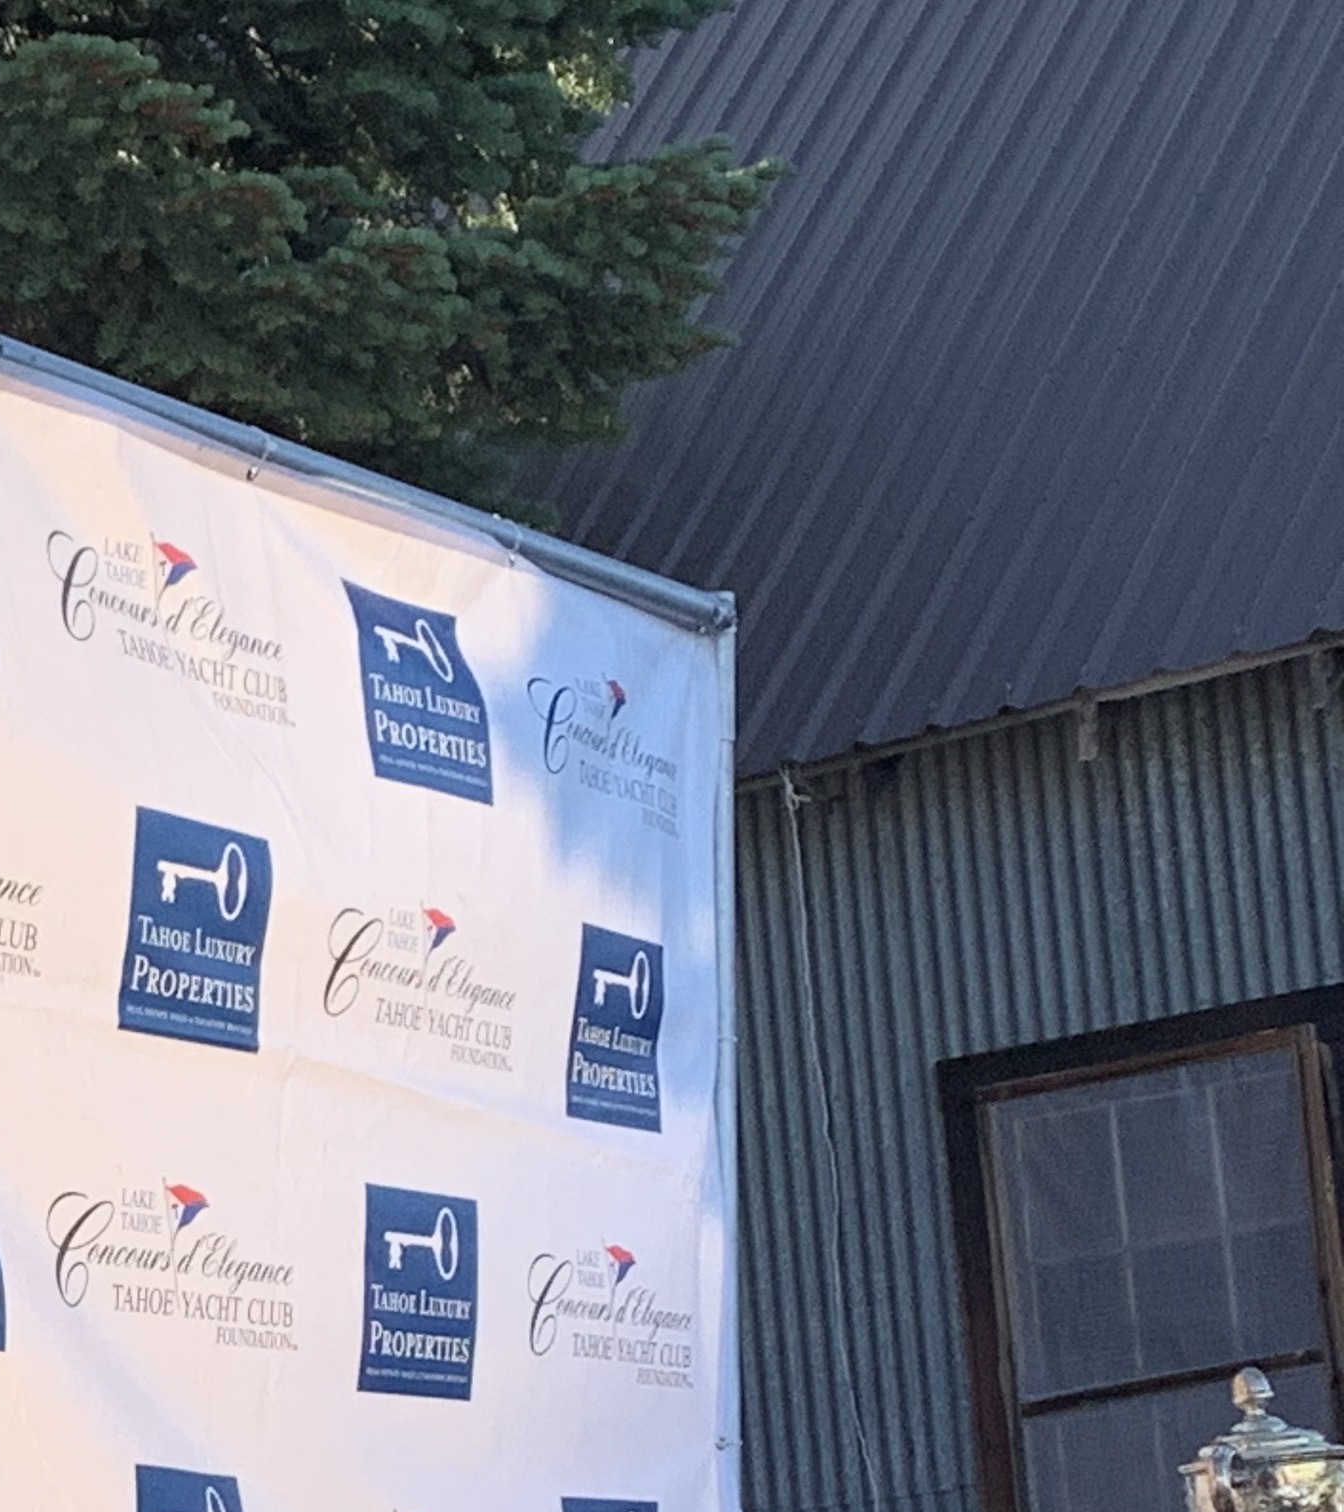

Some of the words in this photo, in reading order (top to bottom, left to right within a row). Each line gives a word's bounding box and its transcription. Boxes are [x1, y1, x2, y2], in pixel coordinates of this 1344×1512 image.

[174, 650, 239, 690] YACHT
[243, 669, 288, 704] CLUB
[374, 710, 486, 768] PROPERTIES
[138, 915, 191, 955] TAHOE
[195, 928, 256, 967] LUXURY
[130, 955, 255, 1014] PROPERTIES
[376, 997, 424, 1031] TAHOE
[428, 1009, 474, 1041] YACHT
[476, 1021, 512, 1050] CLUB
[46, 1192, 171, 1308] Concours
[112, 1284, 176, 1316] TAHOE
[182, 1291, 243, 1322] YACHT
[247, 1299, 294, 1328] CLUB
[369, 1321, 471, 1364] PROPERTIES
